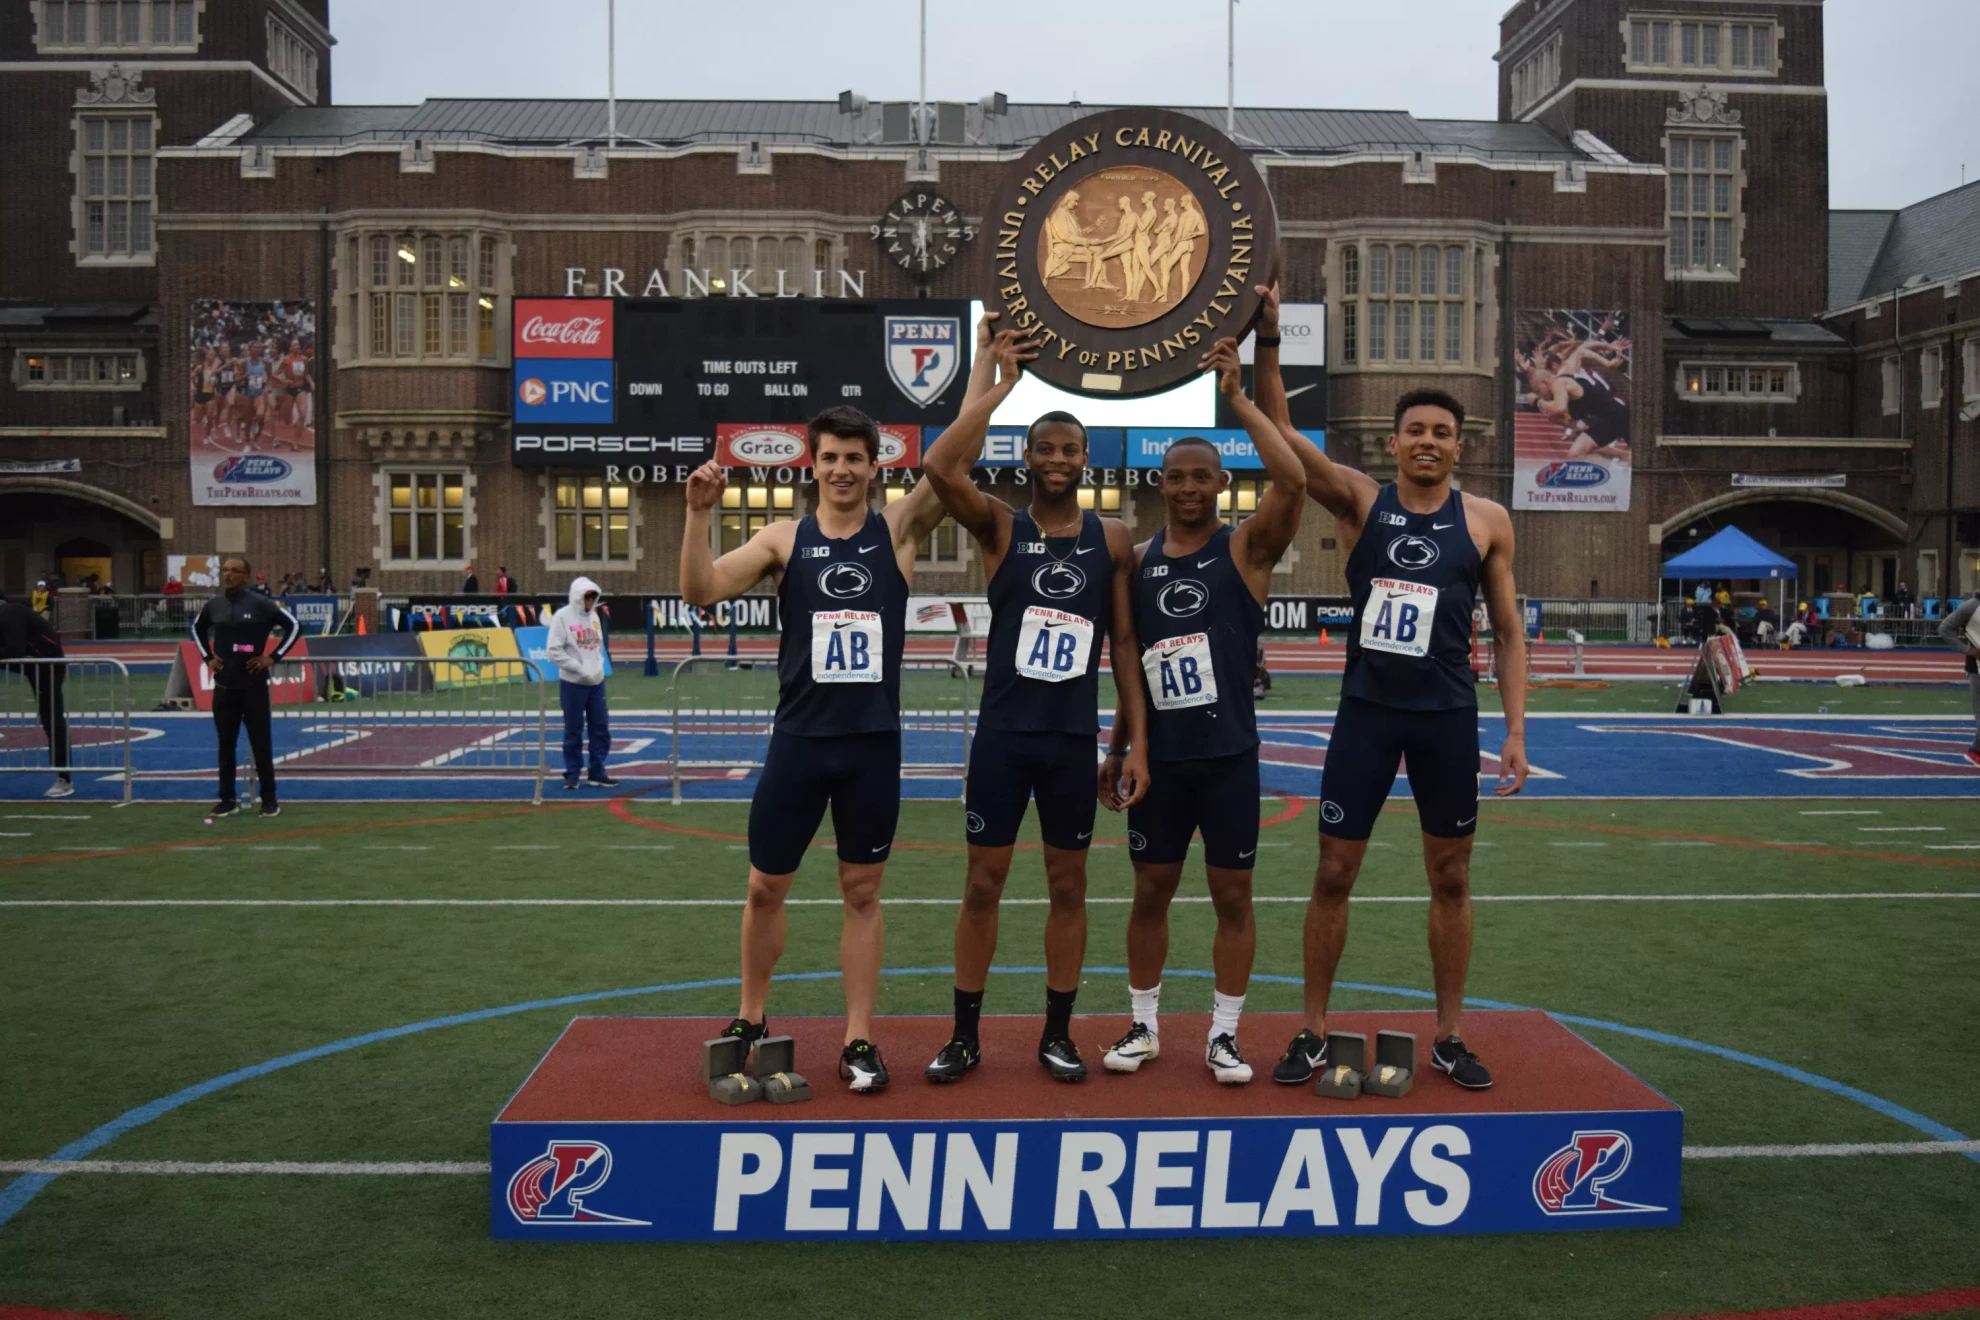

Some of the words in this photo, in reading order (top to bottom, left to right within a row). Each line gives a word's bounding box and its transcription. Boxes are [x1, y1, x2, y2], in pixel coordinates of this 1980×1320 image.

[1022, 132, 1101, 197] RELAY
[1115, 127, 1240, 200] CARNIVAL
[565, 268, 867, 298] FRANKLIN
[996, 210, 1077, 362] UNIVERSITY
[1106, 213, 1254, 372] PENNSYLVANIA
[521, 316, 606, 344] Coca-Cola
[892, 324, 952, 339] PENN
[703, 361, 732, 374] TIME
[734, 361, 767, 374] OUTS
[769, 361, 798, 374] LEFT
[551, 381, 610, 403] PNC
[629, 383, 663, 396] DOWN
[698, 383, 712, 396] TO
[714, 383, 729, 396] GO
[764, 384, 790, 396] BALL
[792, 384, 808, 397] ON
[841, 385, 862, 397] QTR
[515, 436, 705, 452] PORSCHE
[741, 441, 794, 454] Grace
[247, 459, 275, 467] PENN
[1568, 465, 1593, 473] PENN
[244, 467, 282, 475] RELAYS
[606, 465, 734, 483] ROBET
[1398, 582, 1434, 596] RELAYS
[844, 611, 877, 620] RELAYS
[1028, 607, 1053, 618] PENN
[1056, 612, 1090, 627] RELAYS
[1372, 599, 1419, 642] AB
[1170, 634, 1205, 647] RELAYS
[1363, 637, 1413, 652] Independence
[825, 631, 870, 670] AB
[1027, 628, 1077, 672] AB
[816, 672, 870, 680] Independence
[1160, 656, 1202, 698] AB
[713, 1132, 1019, 1232] PENN
[1053, 1124, 1472, 1230] RELAYS
